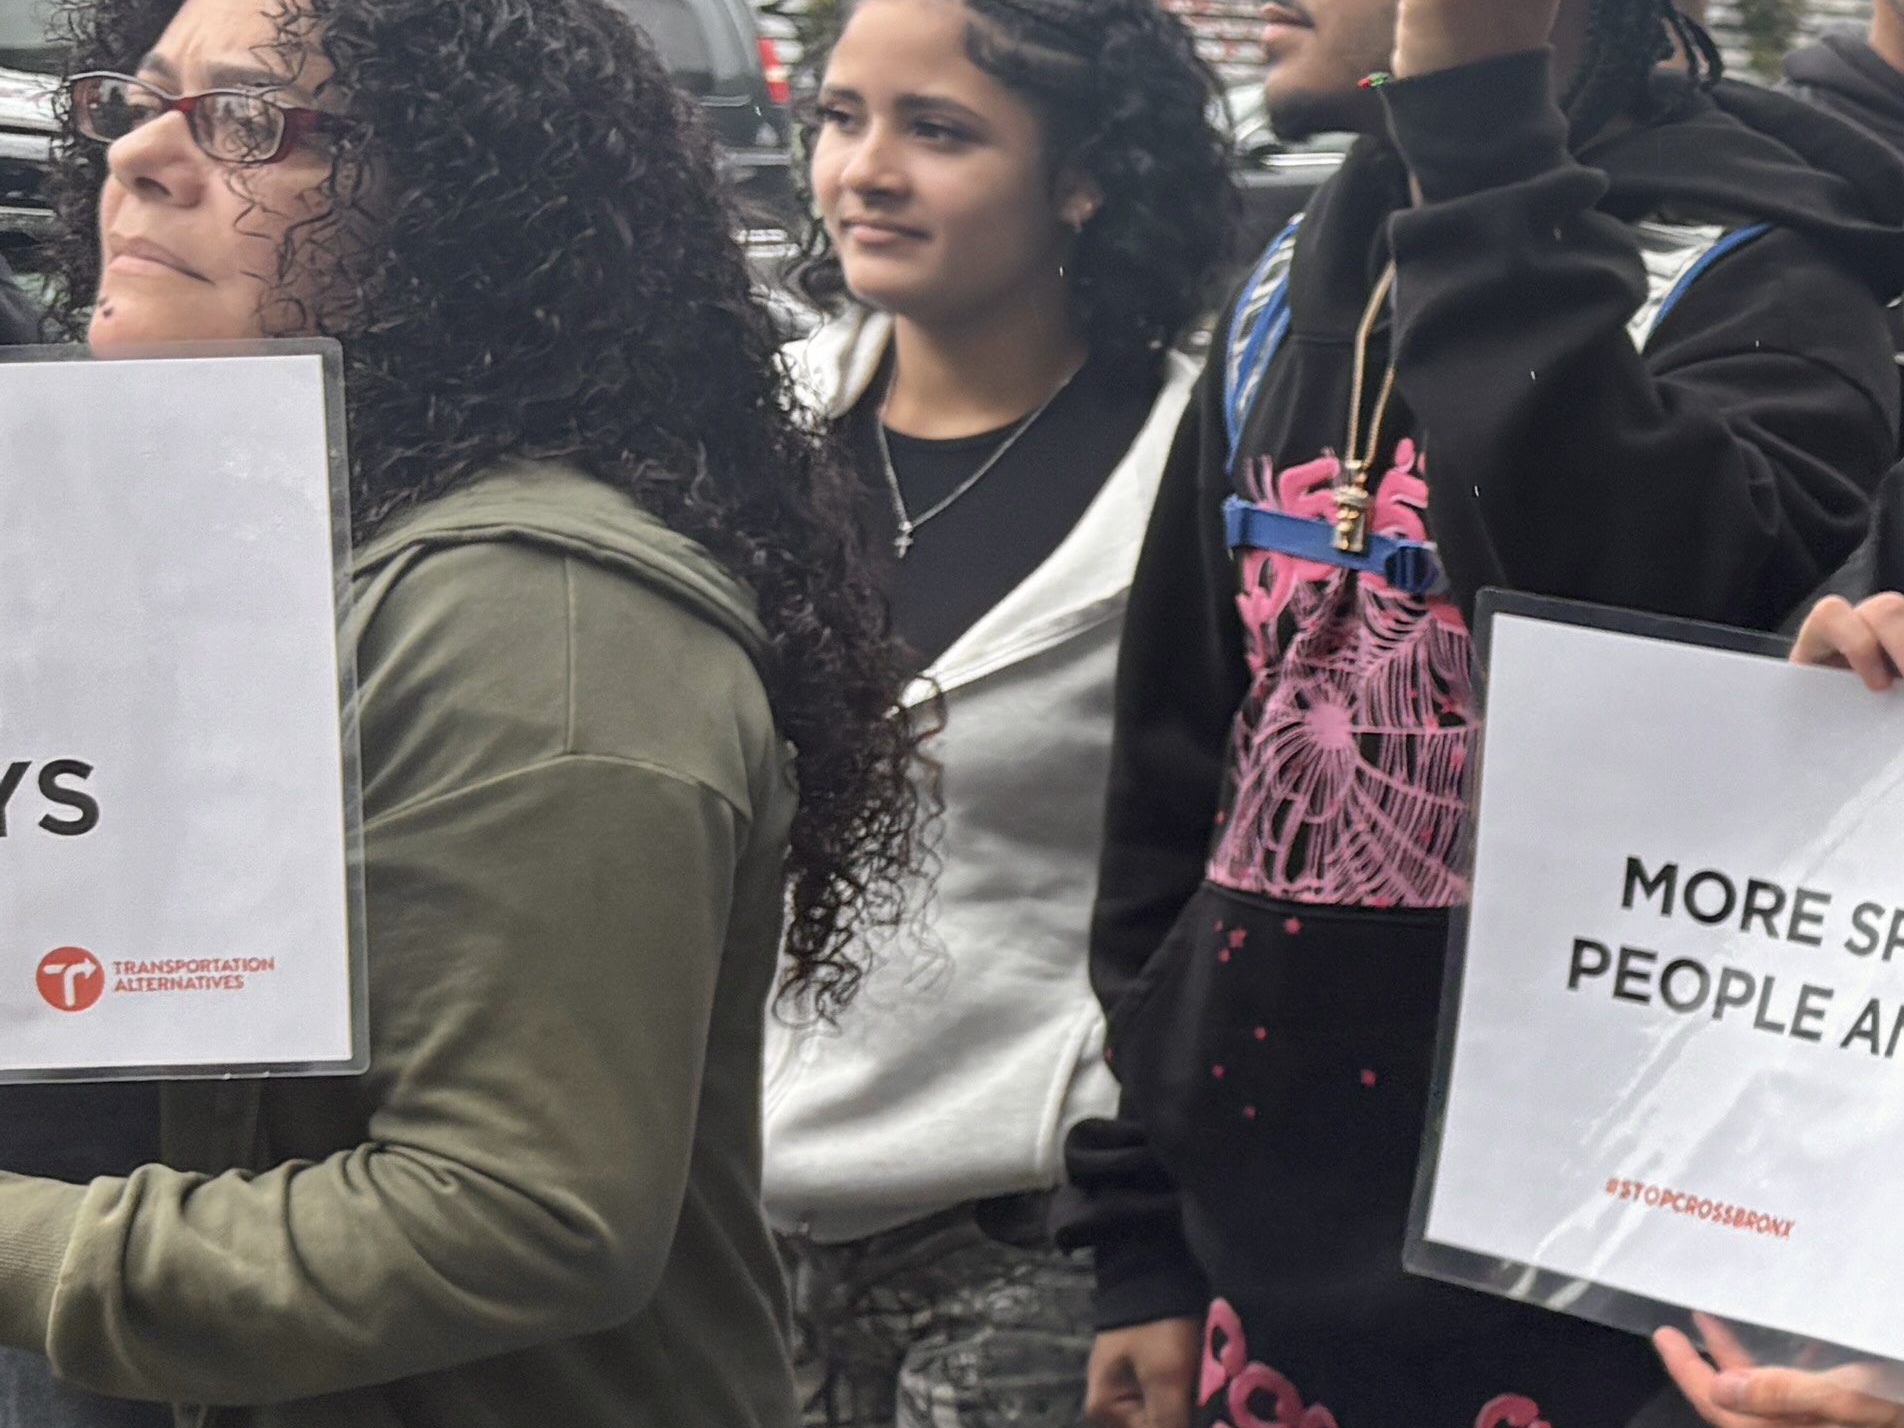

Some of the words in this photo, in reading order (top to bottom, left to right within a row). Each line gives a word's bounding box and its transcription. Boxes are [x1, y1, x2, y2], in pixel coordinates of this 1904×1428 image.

[1620, 855, 1832, 947] MORE
[112, 956, 275, 975] TRANSPORTATION
[113, 973, 245, 993] ALTERNATIVES
[1566, 937, 1835, 1042] PEOPLE
[1605, 1177, 1796, 1240] #STOPCROSSBRONX
